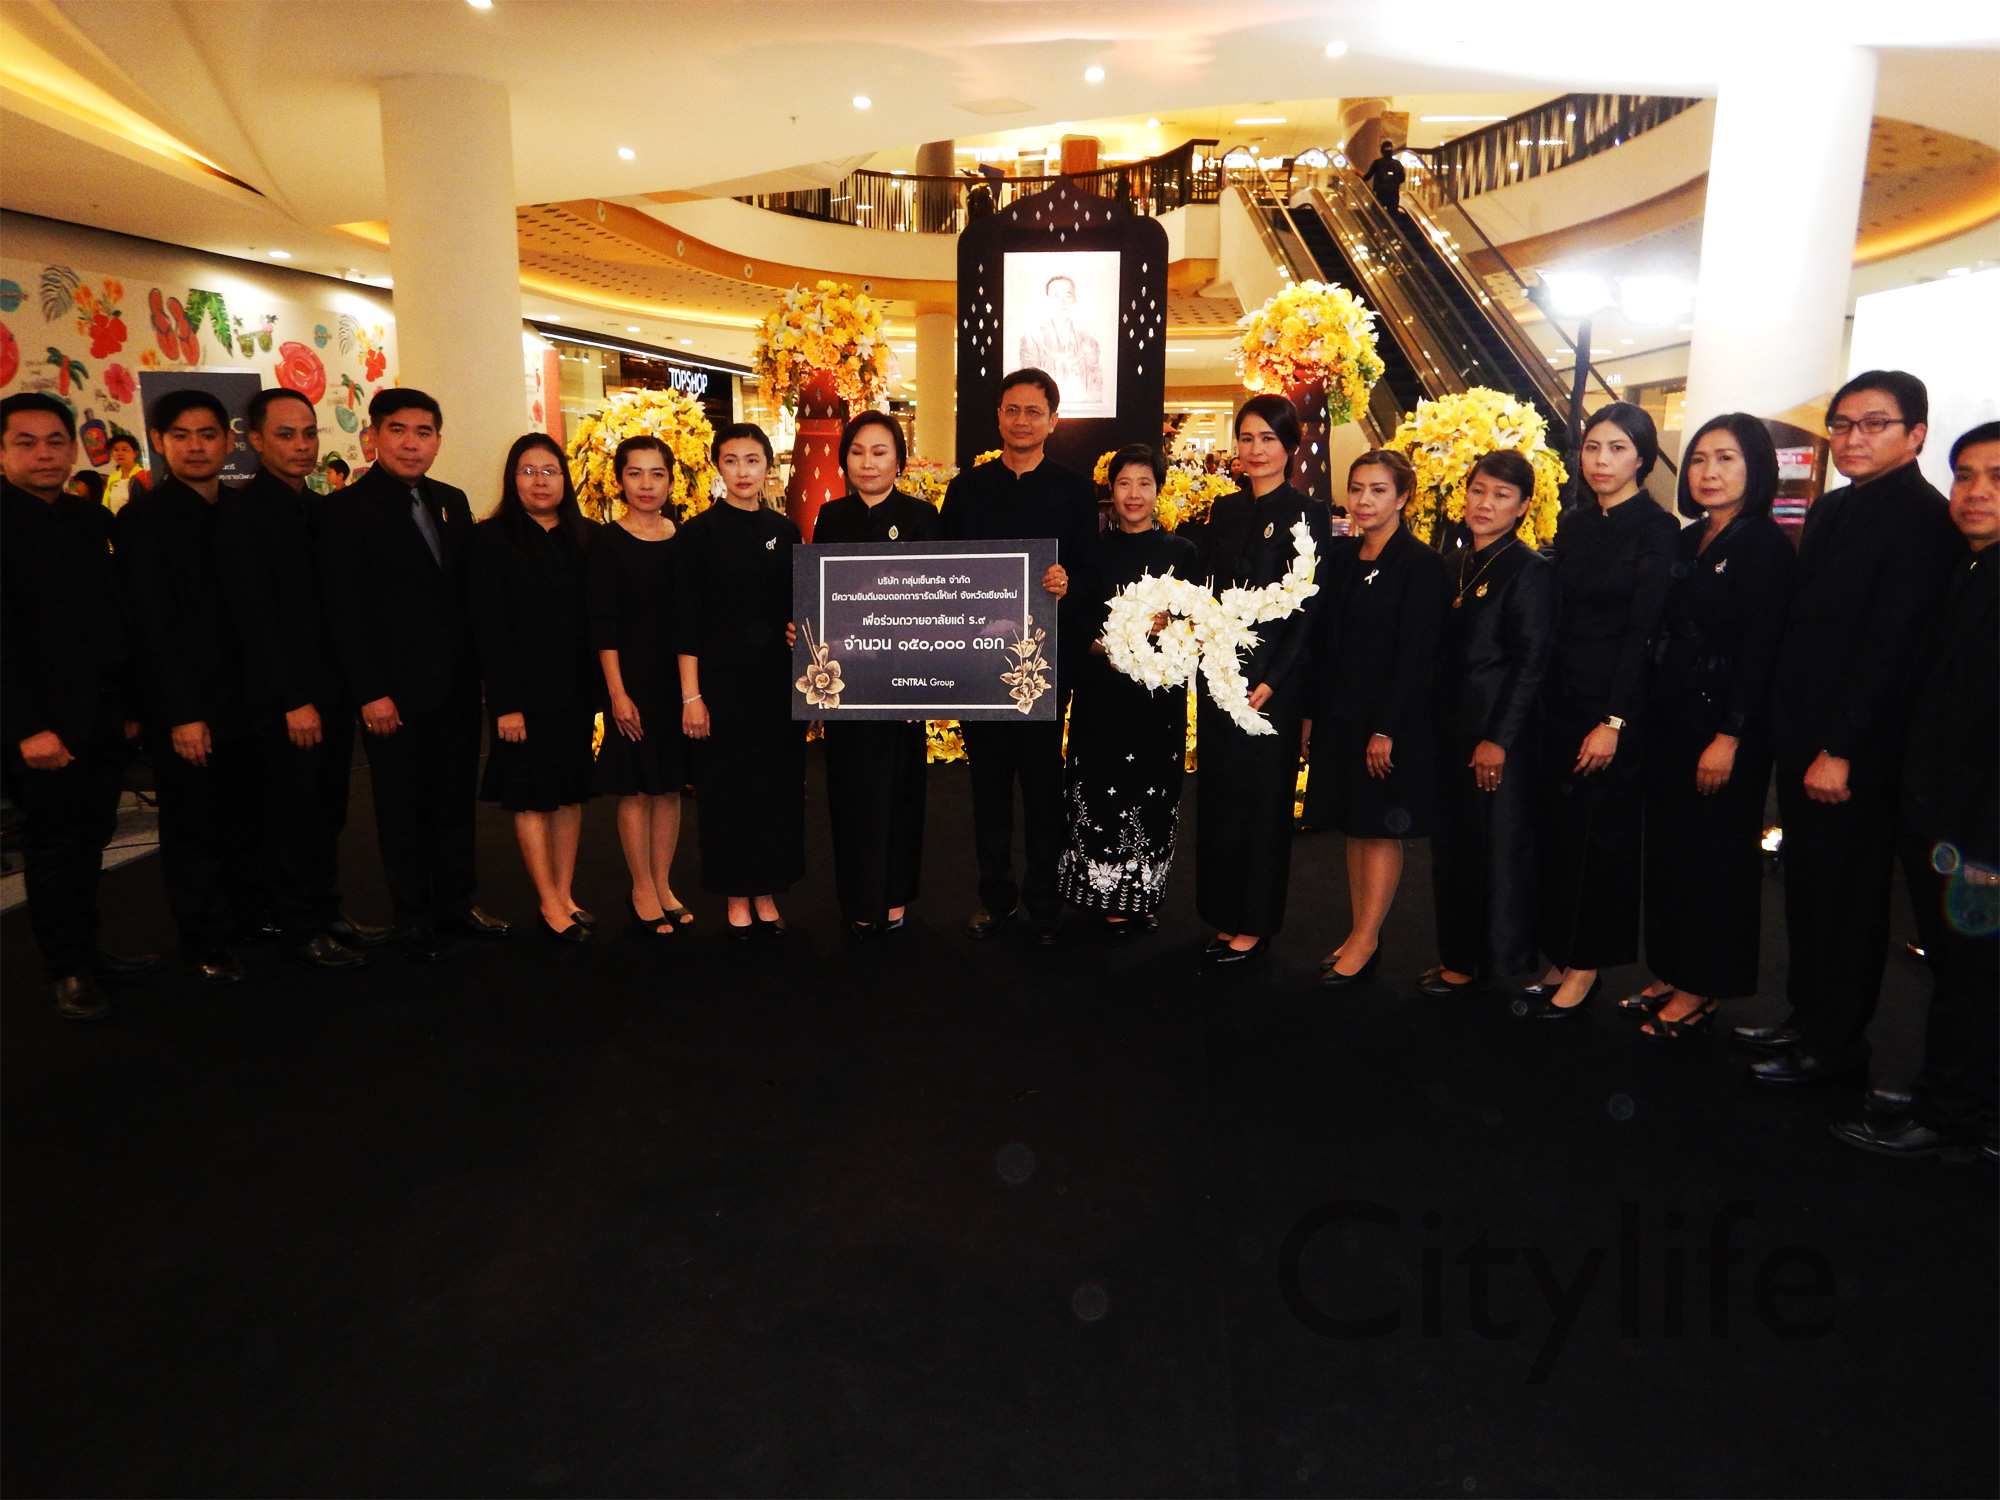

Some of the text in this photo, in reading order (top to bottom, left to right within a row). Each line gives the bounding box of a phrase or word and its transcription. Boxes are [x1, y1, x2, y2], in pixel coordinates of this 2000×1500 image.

[668, 367, 708, 394] TOPSHOP
[877, 575, 899, 586] บริษัท
[949, 574, 971, 585] จำกัด
[960, 588, 1018, 601] จังหวัดเชียงใหม่
[862, 612, 986, 626] เพื่อร่วมถวายอาลัยแด่ ร.๙
[844, 635, 1005, 652] จำนวน ๑๕๐,๐๐๐ ดอก
[891, 678, 955, 690] CENTRAL Group
